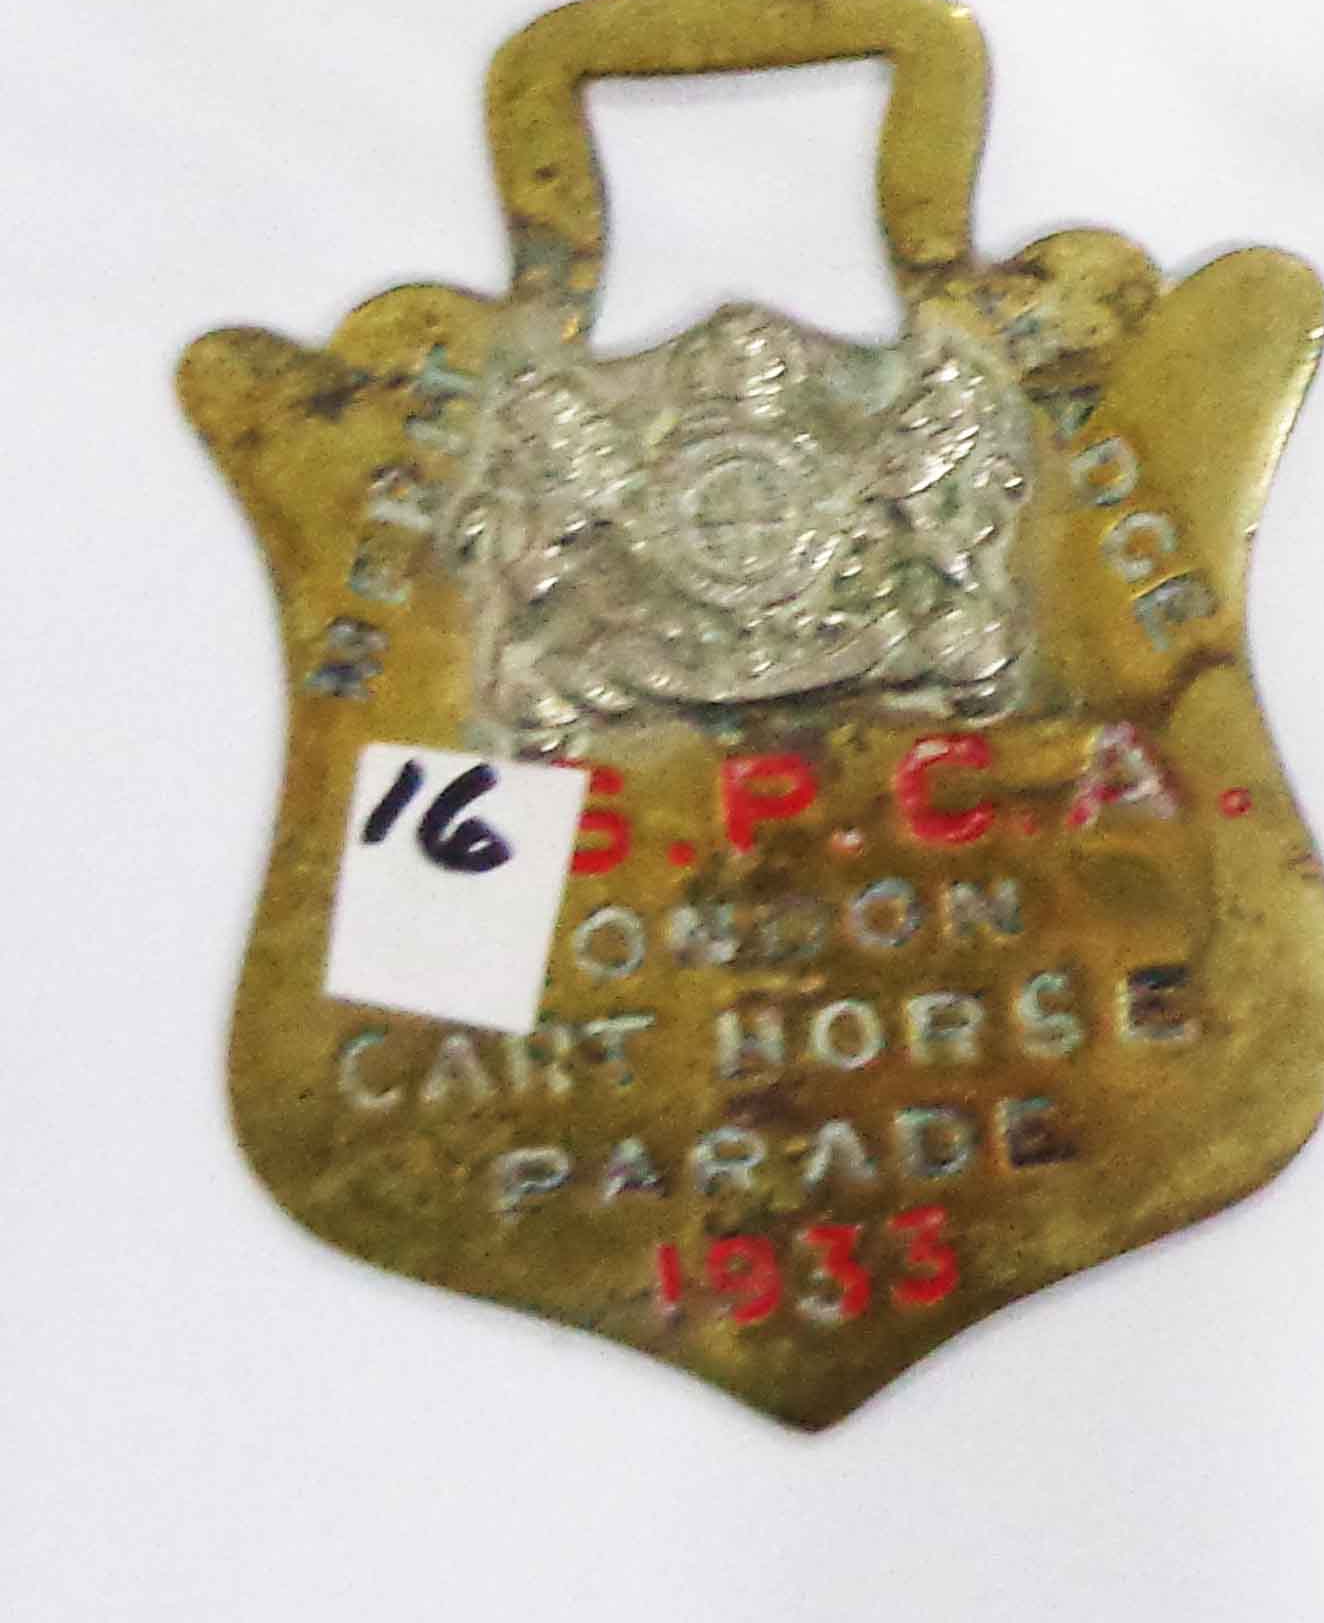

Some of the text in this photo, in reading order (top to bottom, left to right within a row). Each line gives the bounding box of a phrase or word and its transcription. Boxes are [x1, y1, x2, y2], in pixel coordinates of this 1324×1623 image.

[361, 760, 512, 874] 16
[573, 876, 1023, 982] ONDON
[340, 962, 1201, 1112] CART HORSE
[496, 1094, 1080, 1212] PARADE
[654, 1203, 962, 1328] 1933
